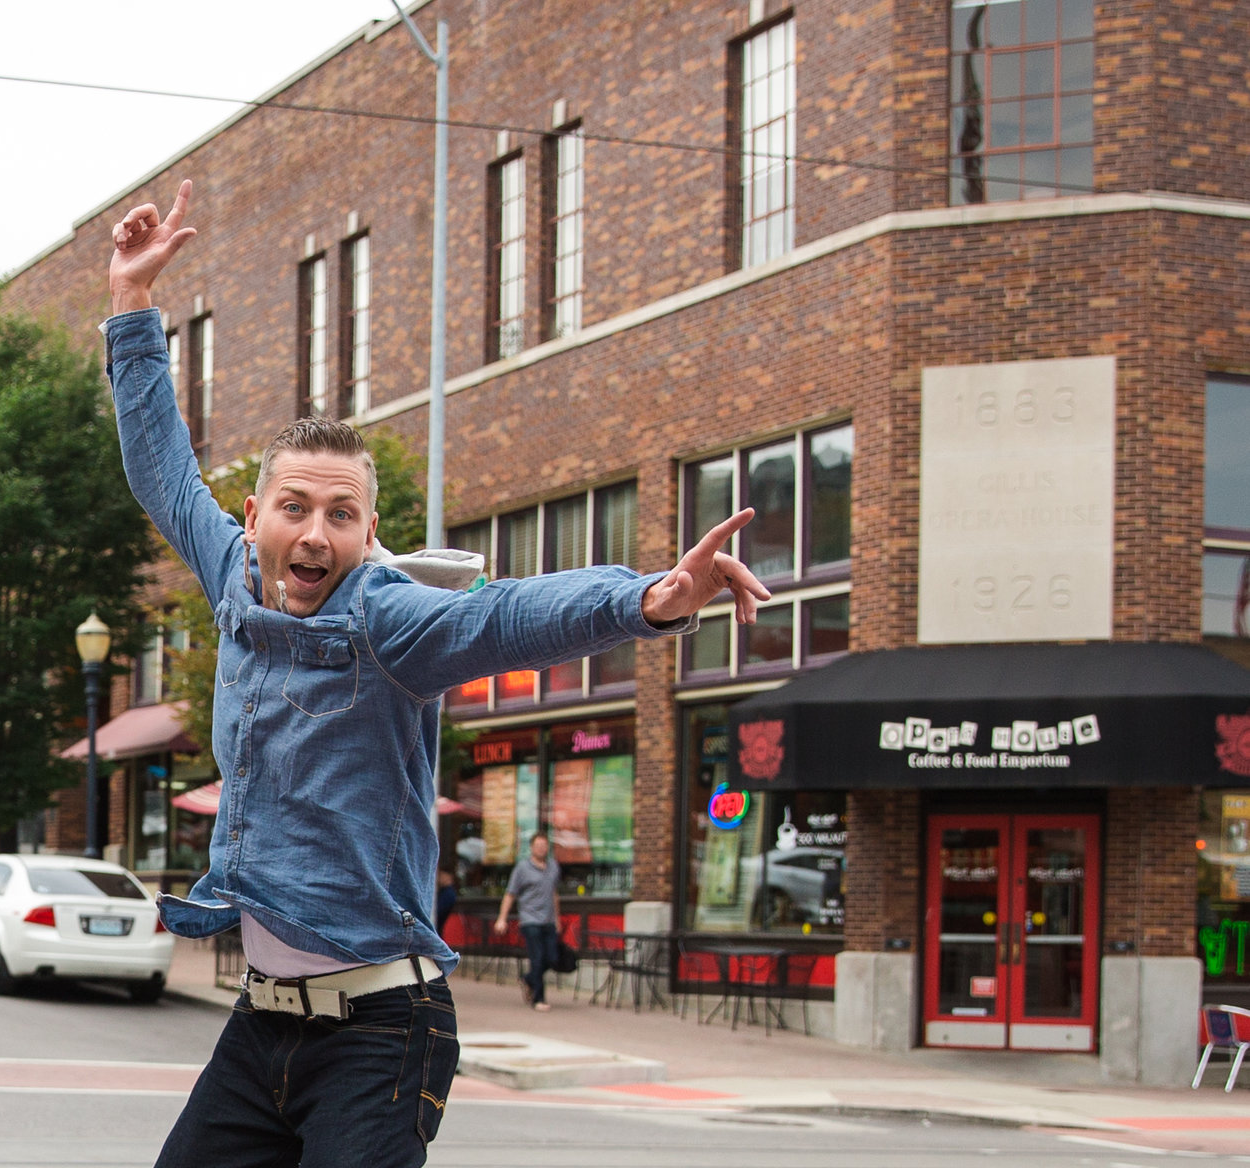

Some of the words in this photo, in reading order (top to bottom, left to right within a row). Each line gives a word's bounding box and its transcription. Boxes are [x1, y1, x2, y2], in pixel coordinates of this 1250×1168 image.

[954, 386, 1076, 429] 1883
[1021, 504, 1103, 528] HOUSE
[952, 574, 1072, 615] 1926
[474, 742, 512, 765] LUNCH
[908, 752, 950, 768] Coffee
[951, 752, 963, 768] &
[965, 752, 997, 768] Food
[1000, 752, 1070, 770] Emporium
